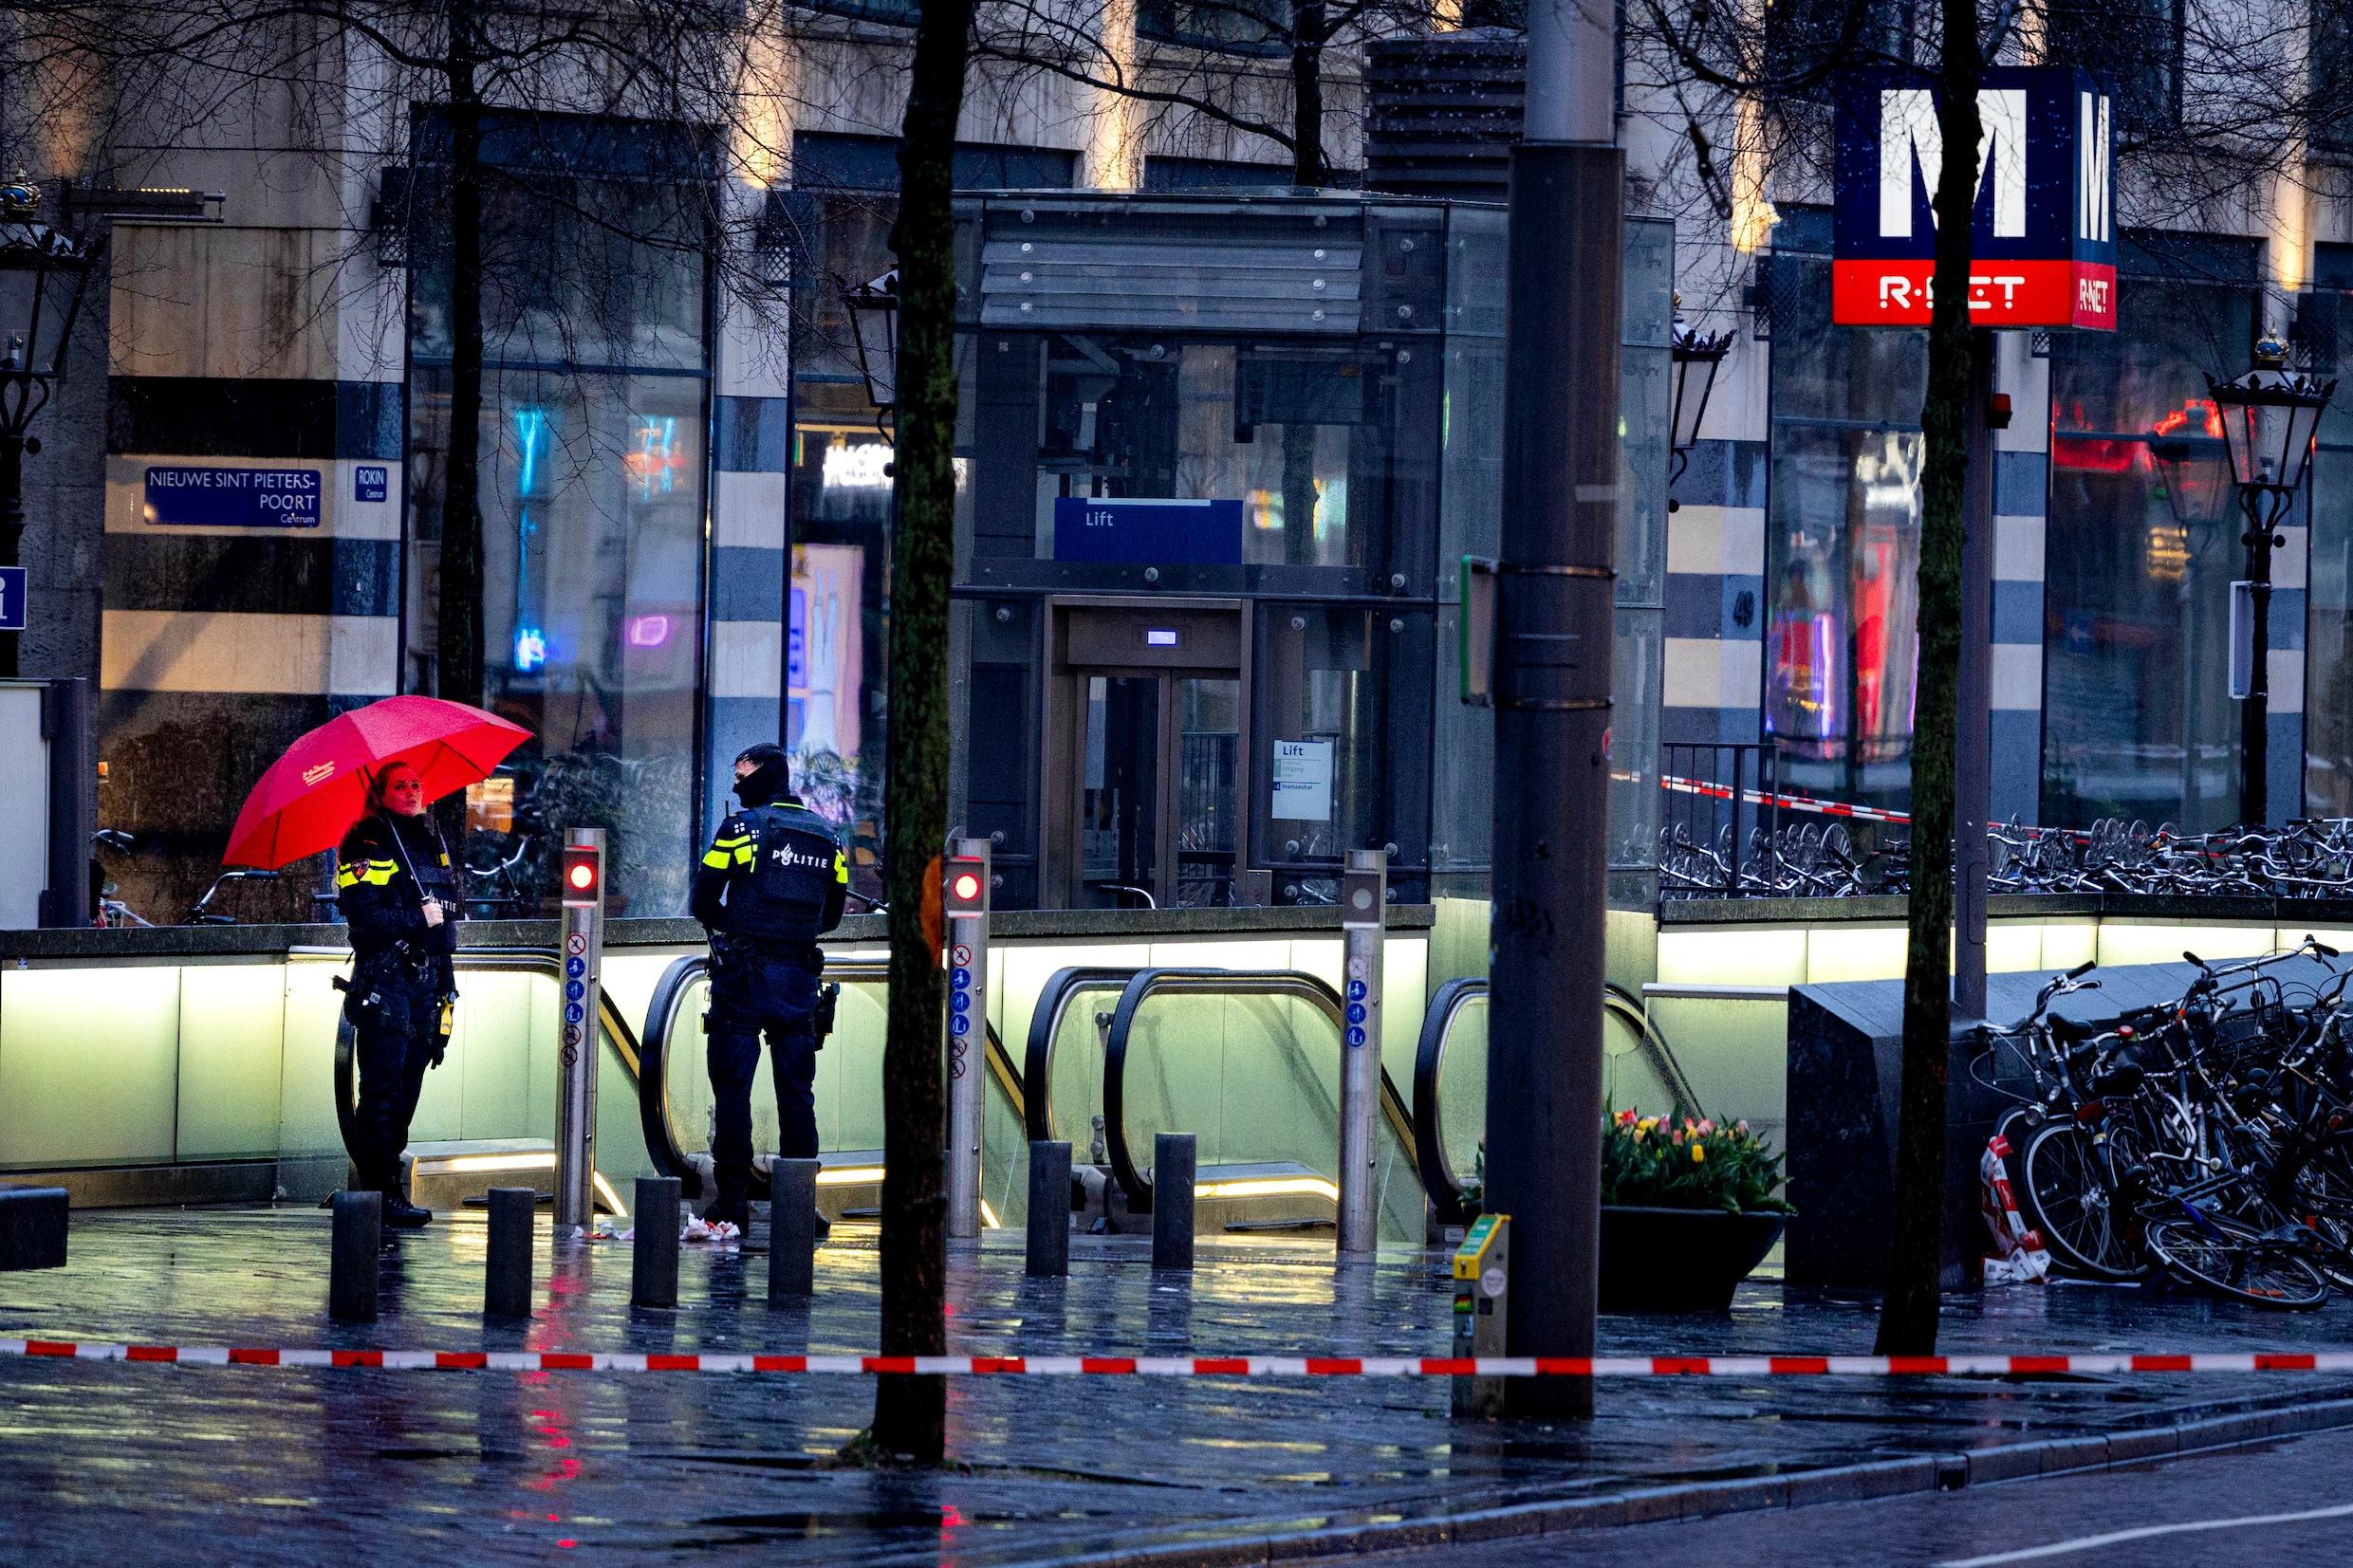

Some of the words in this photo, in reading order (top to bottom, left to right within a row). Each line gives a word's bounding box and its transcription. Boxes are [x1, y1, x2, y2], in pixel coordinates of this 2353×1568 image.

[1880, 89, 2027, 237] M
[2080, 91, 2109, 242] M
[150, 471, 212, 488] NIEUWE
[215, 473, 250, 489] SINT
[254, 473, 316, 489] PIETERS-
[359, 470, 384, 485] ROKIN
[259, 494, 316, 510] POORT
[1085, 511, 1114, 526] Lift
[1283, 745, 1304, 756] Lift
[771, 843, 828, 868] POLITIE
